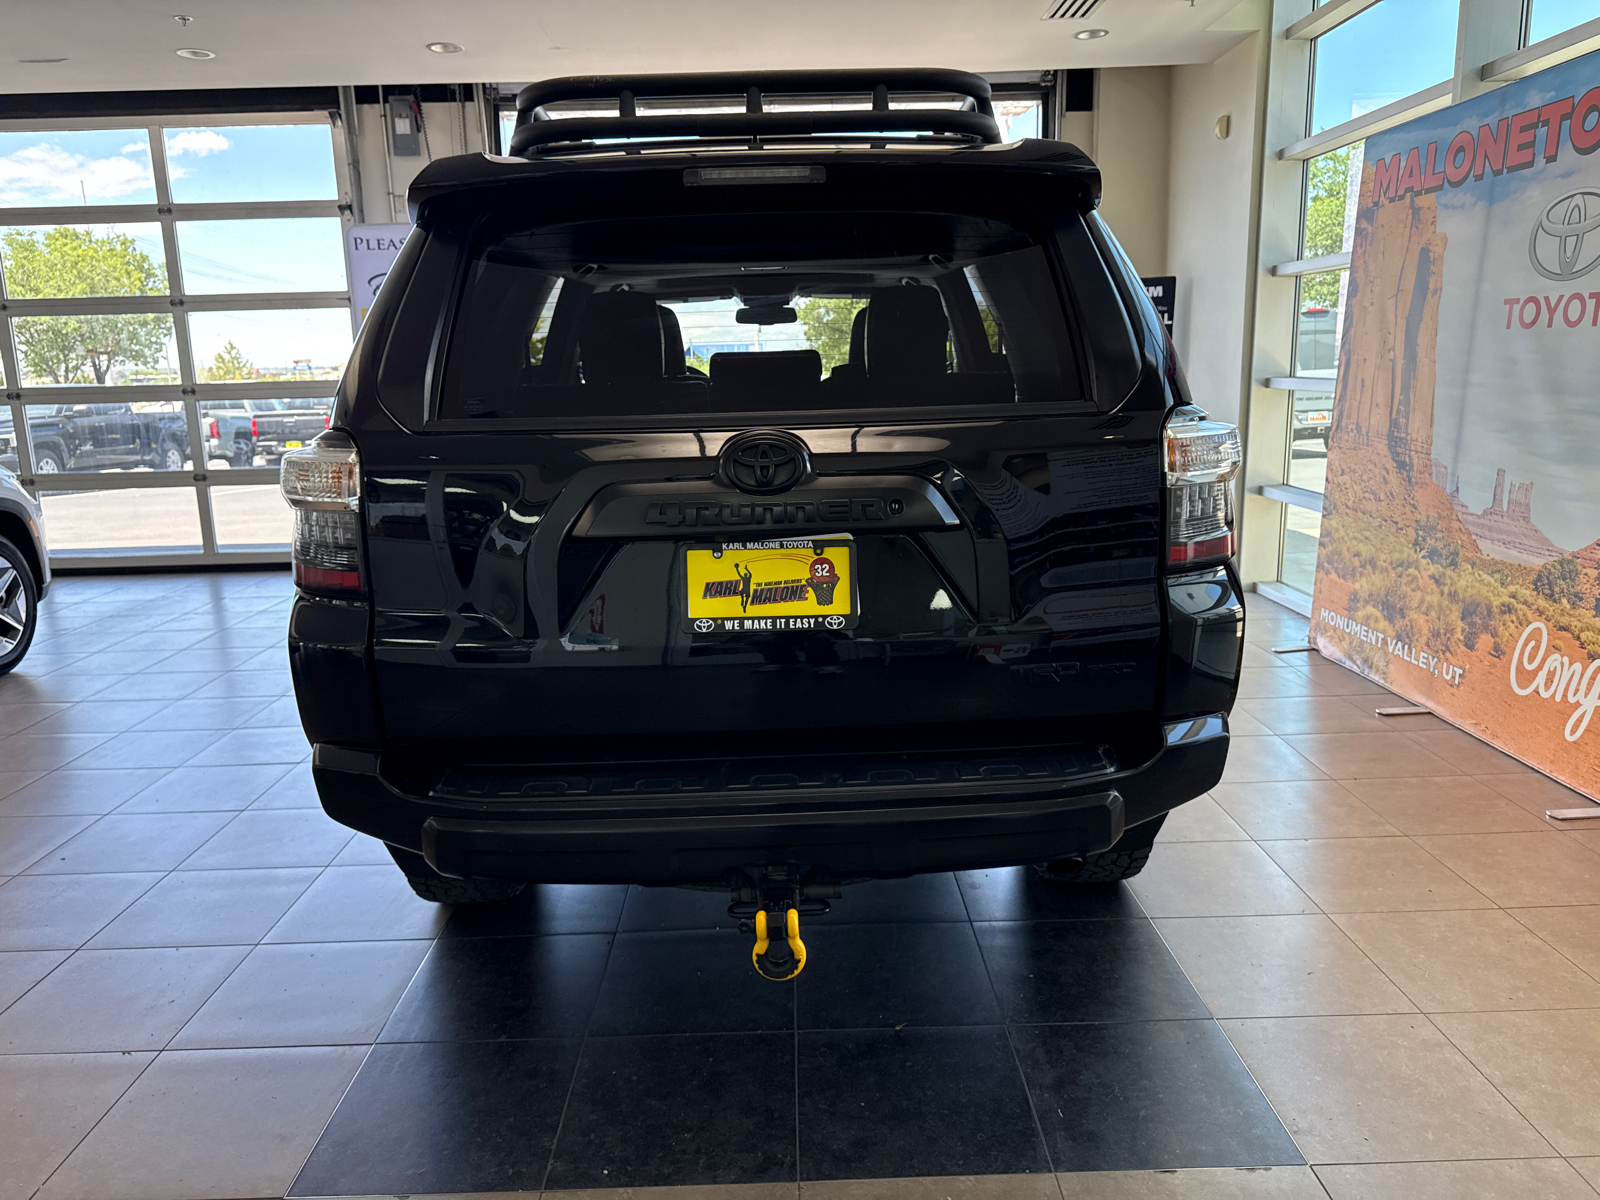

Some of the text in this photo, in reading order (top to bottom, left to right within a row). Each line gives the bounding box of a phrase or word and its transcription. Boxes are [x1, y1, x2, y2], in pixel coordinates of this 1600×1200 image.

[722, 540, 814, 551] KARL MALONE TOYOTA
[814, 563, 830, 577] 32
[702, 579, 809, 606] KARL MALONE
[724, 617, 816, 630] WE MAKE IT EASY
[1320, 607, 1464, 685] MONUMENT VALLEY, UT
[1510, 621, 1600, 742] Cong
